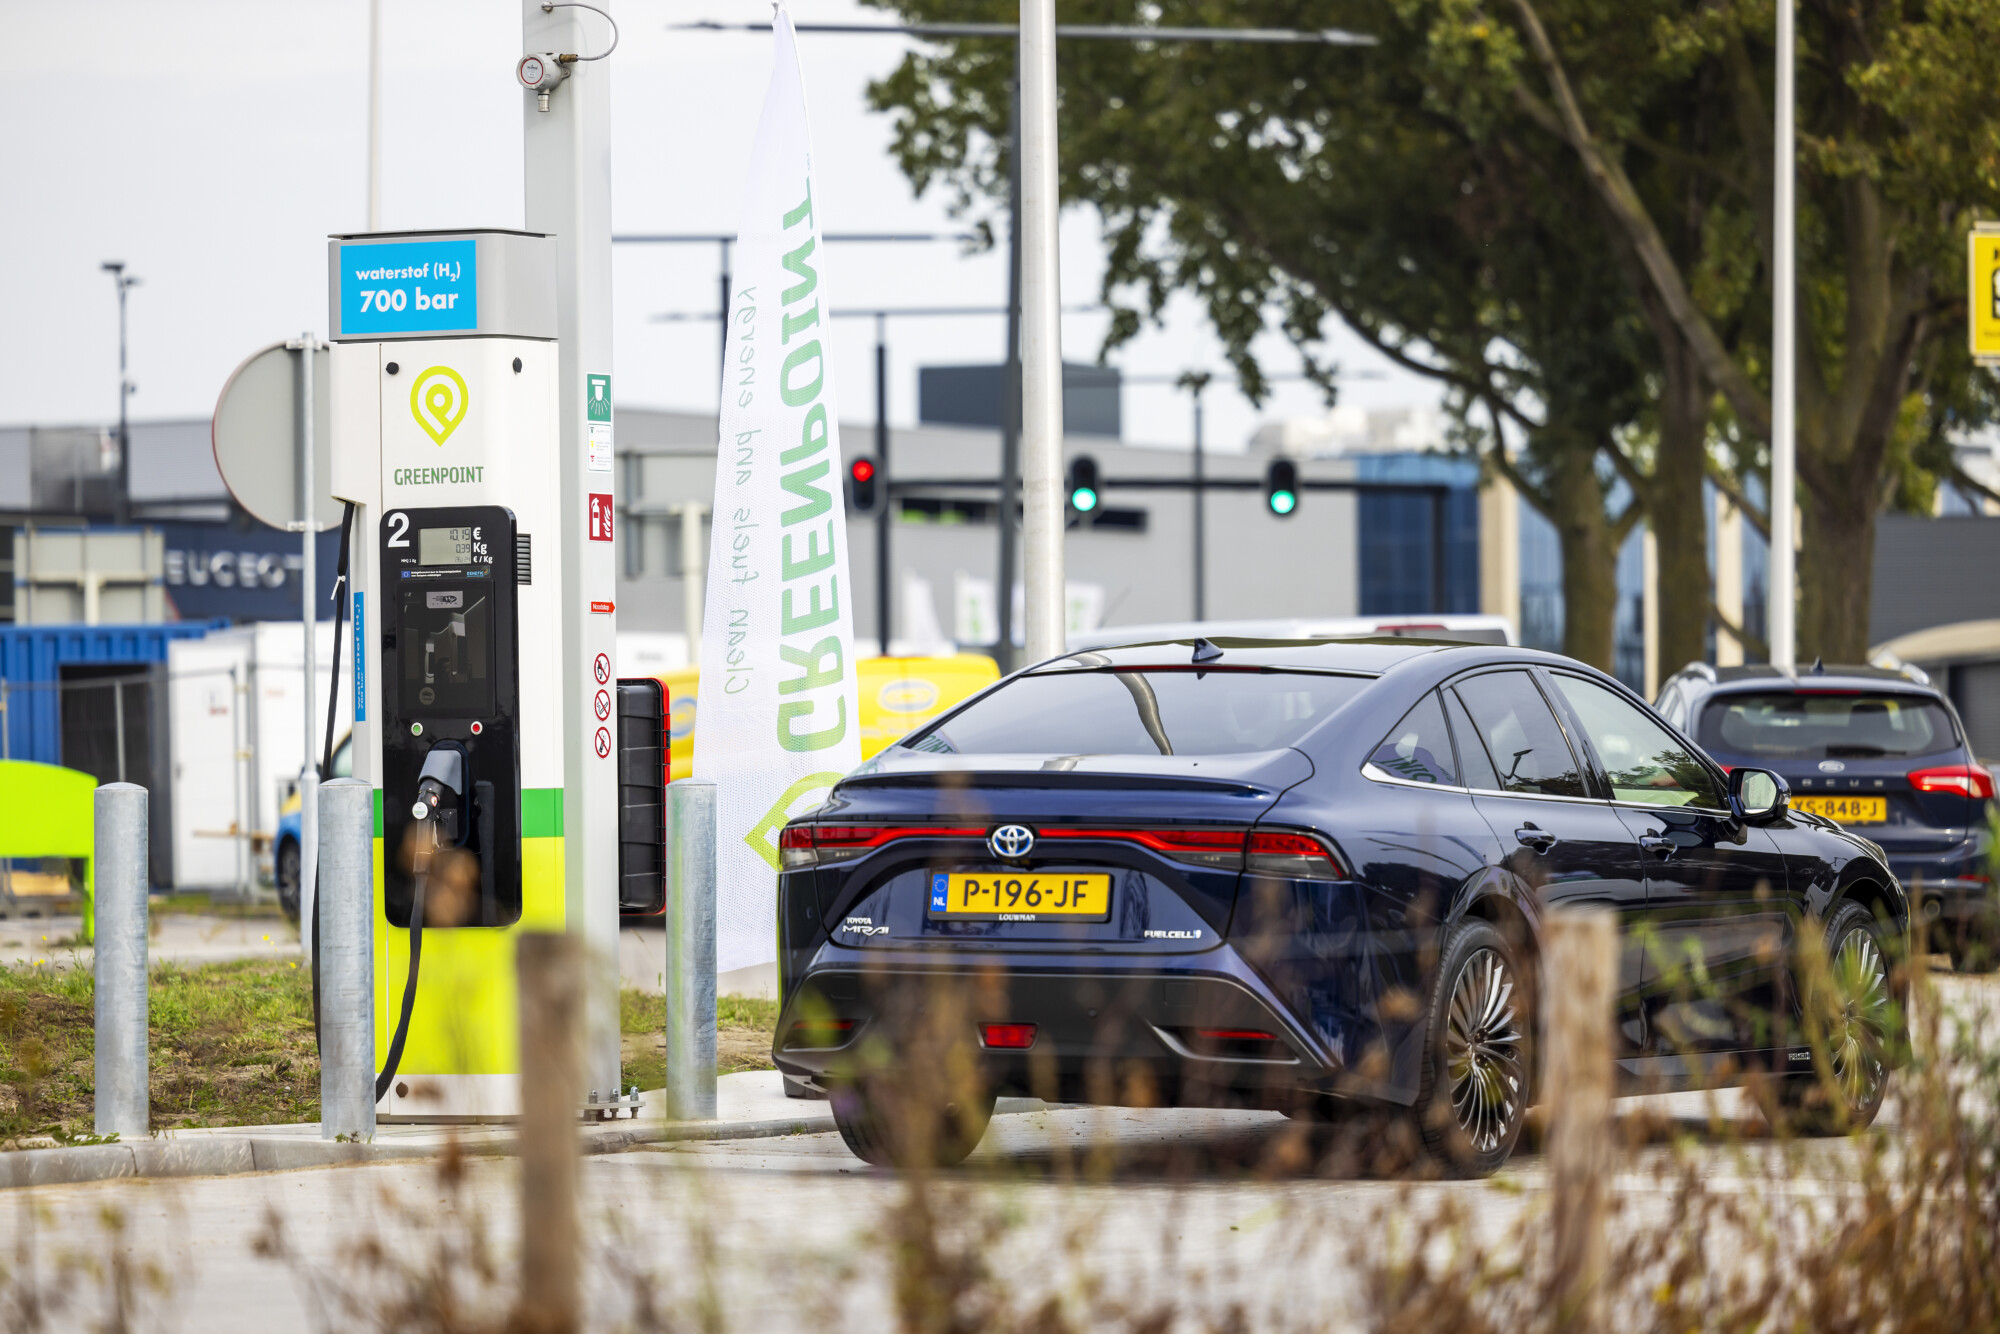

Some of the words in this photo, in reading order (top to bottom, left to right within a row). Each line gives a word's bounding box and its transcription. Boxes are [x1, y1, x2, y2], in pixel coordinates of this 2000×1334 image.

[355, 262, 429, 280] waterstof
[360, 289, 407, 312] 700
[415, 287, 459, 310] bar
[394, 466, 484, 485] GREENPOINT
[387, 511, 410, 548] 2
[473, 527, 482, 540] €
[473, 542, 487, 555] Kg
[483, 555, 493, 564] Kg
[166, 549, 304, 588] EUGEOT
[933, 896, 945, 906] NL
[963, 879, 1089, 908] P-196-JF
[998, 913, 1036, 921] LOUWMAN
[842, 925, 890, 936] MIRAI
